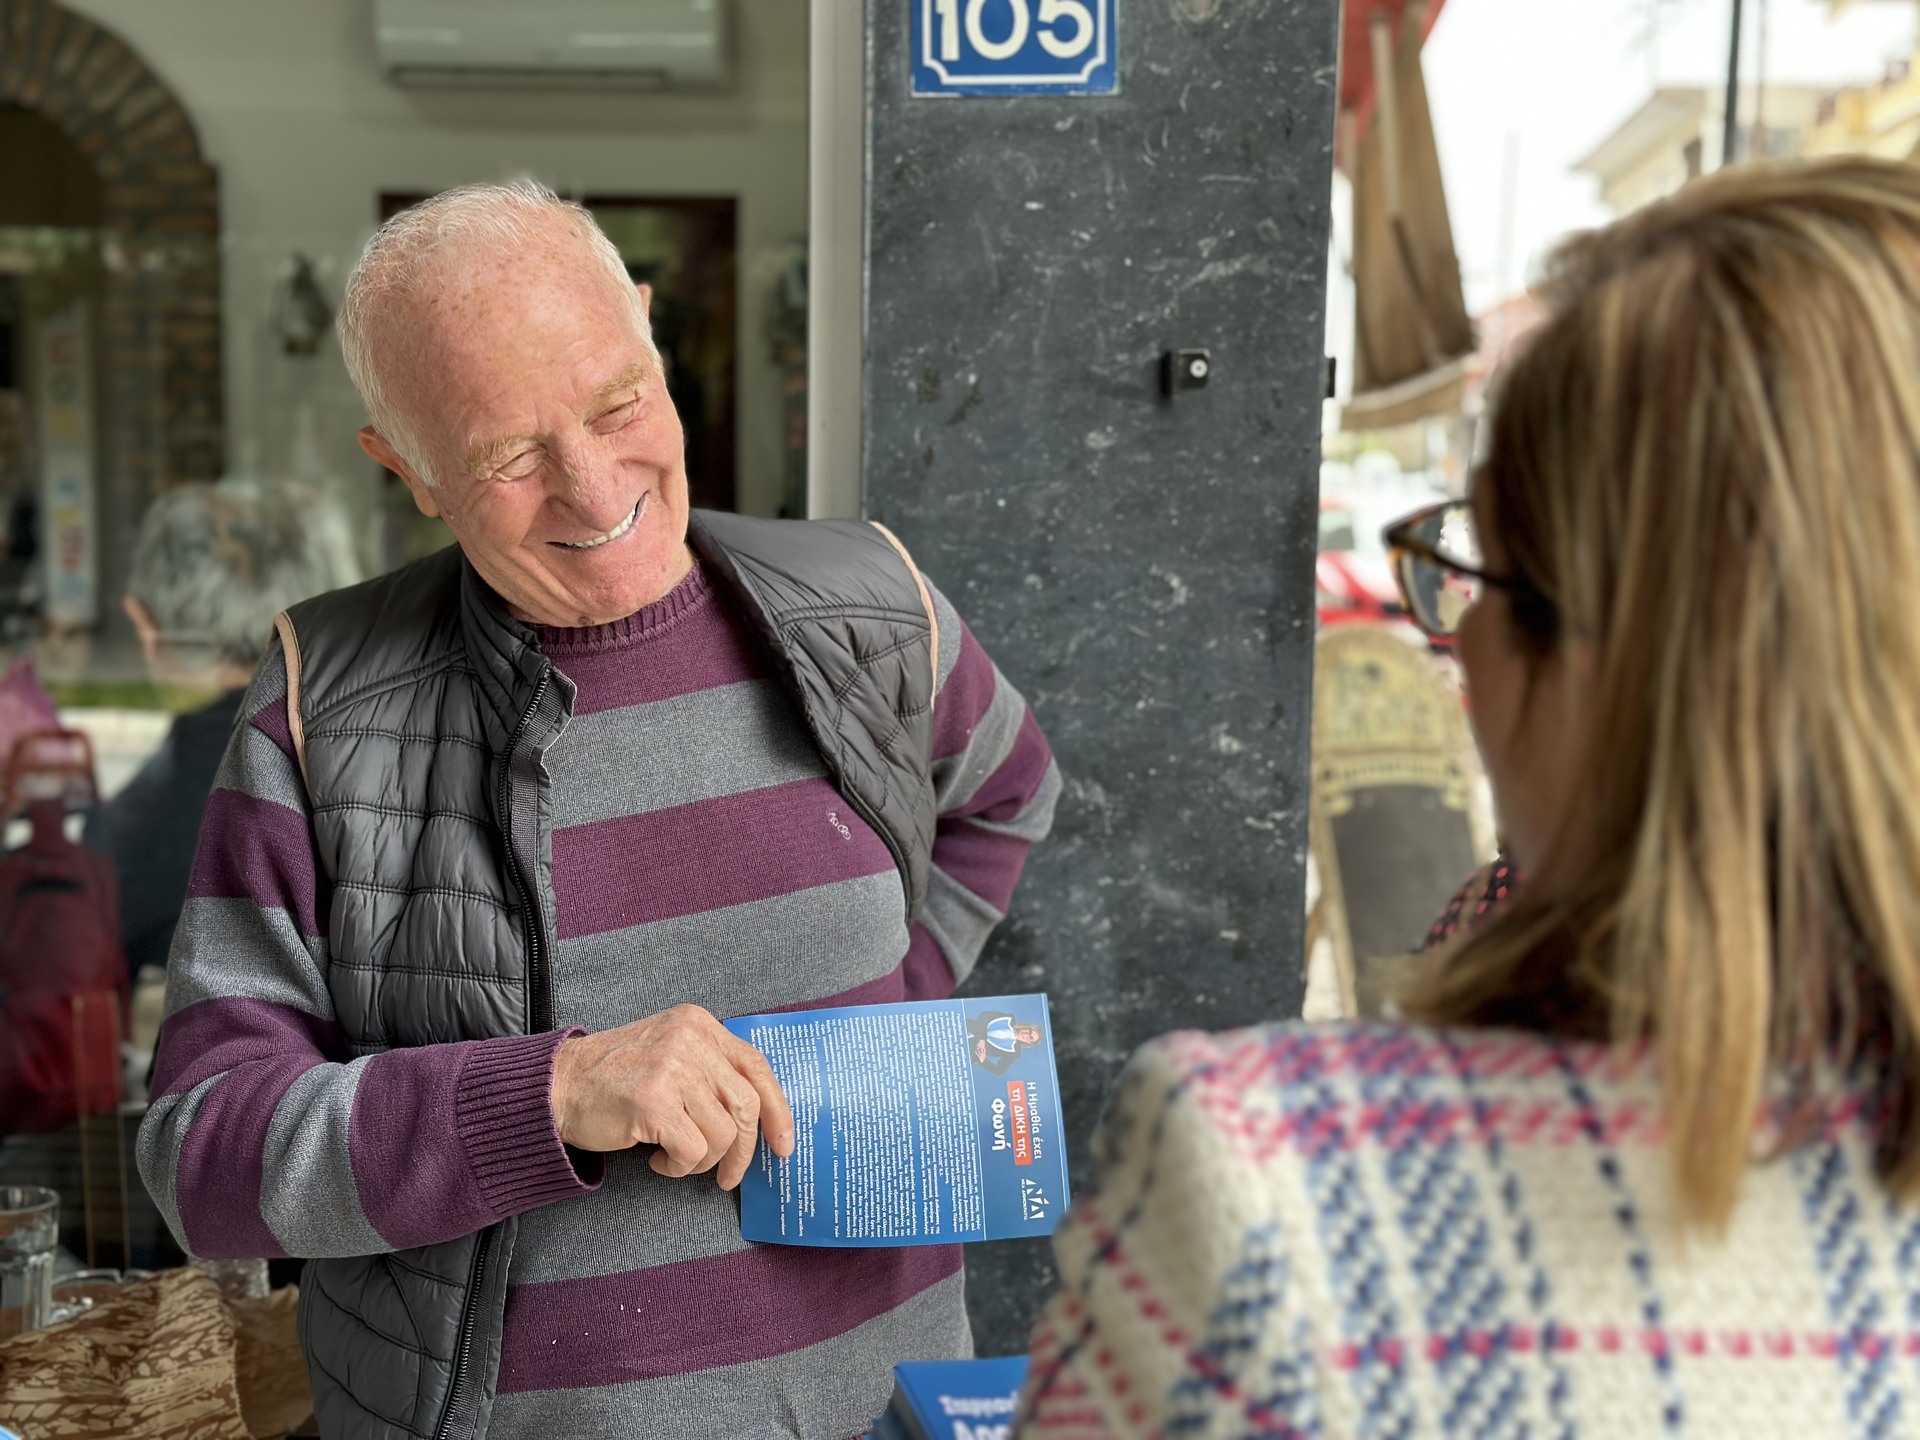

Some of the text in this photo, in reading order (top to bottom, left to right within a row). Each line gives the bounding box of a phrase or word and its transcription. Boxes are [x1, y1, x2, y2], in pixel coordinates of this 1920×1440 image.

[935, 0, 1094, 61] 105
[990, 1097, 1012, 1151] Φωνή
[1010, 1087, 1027, 1158] τη ΔΙΚΗ της
[1025, 1081, 1044, 1160] Η Ημαθία έχει
